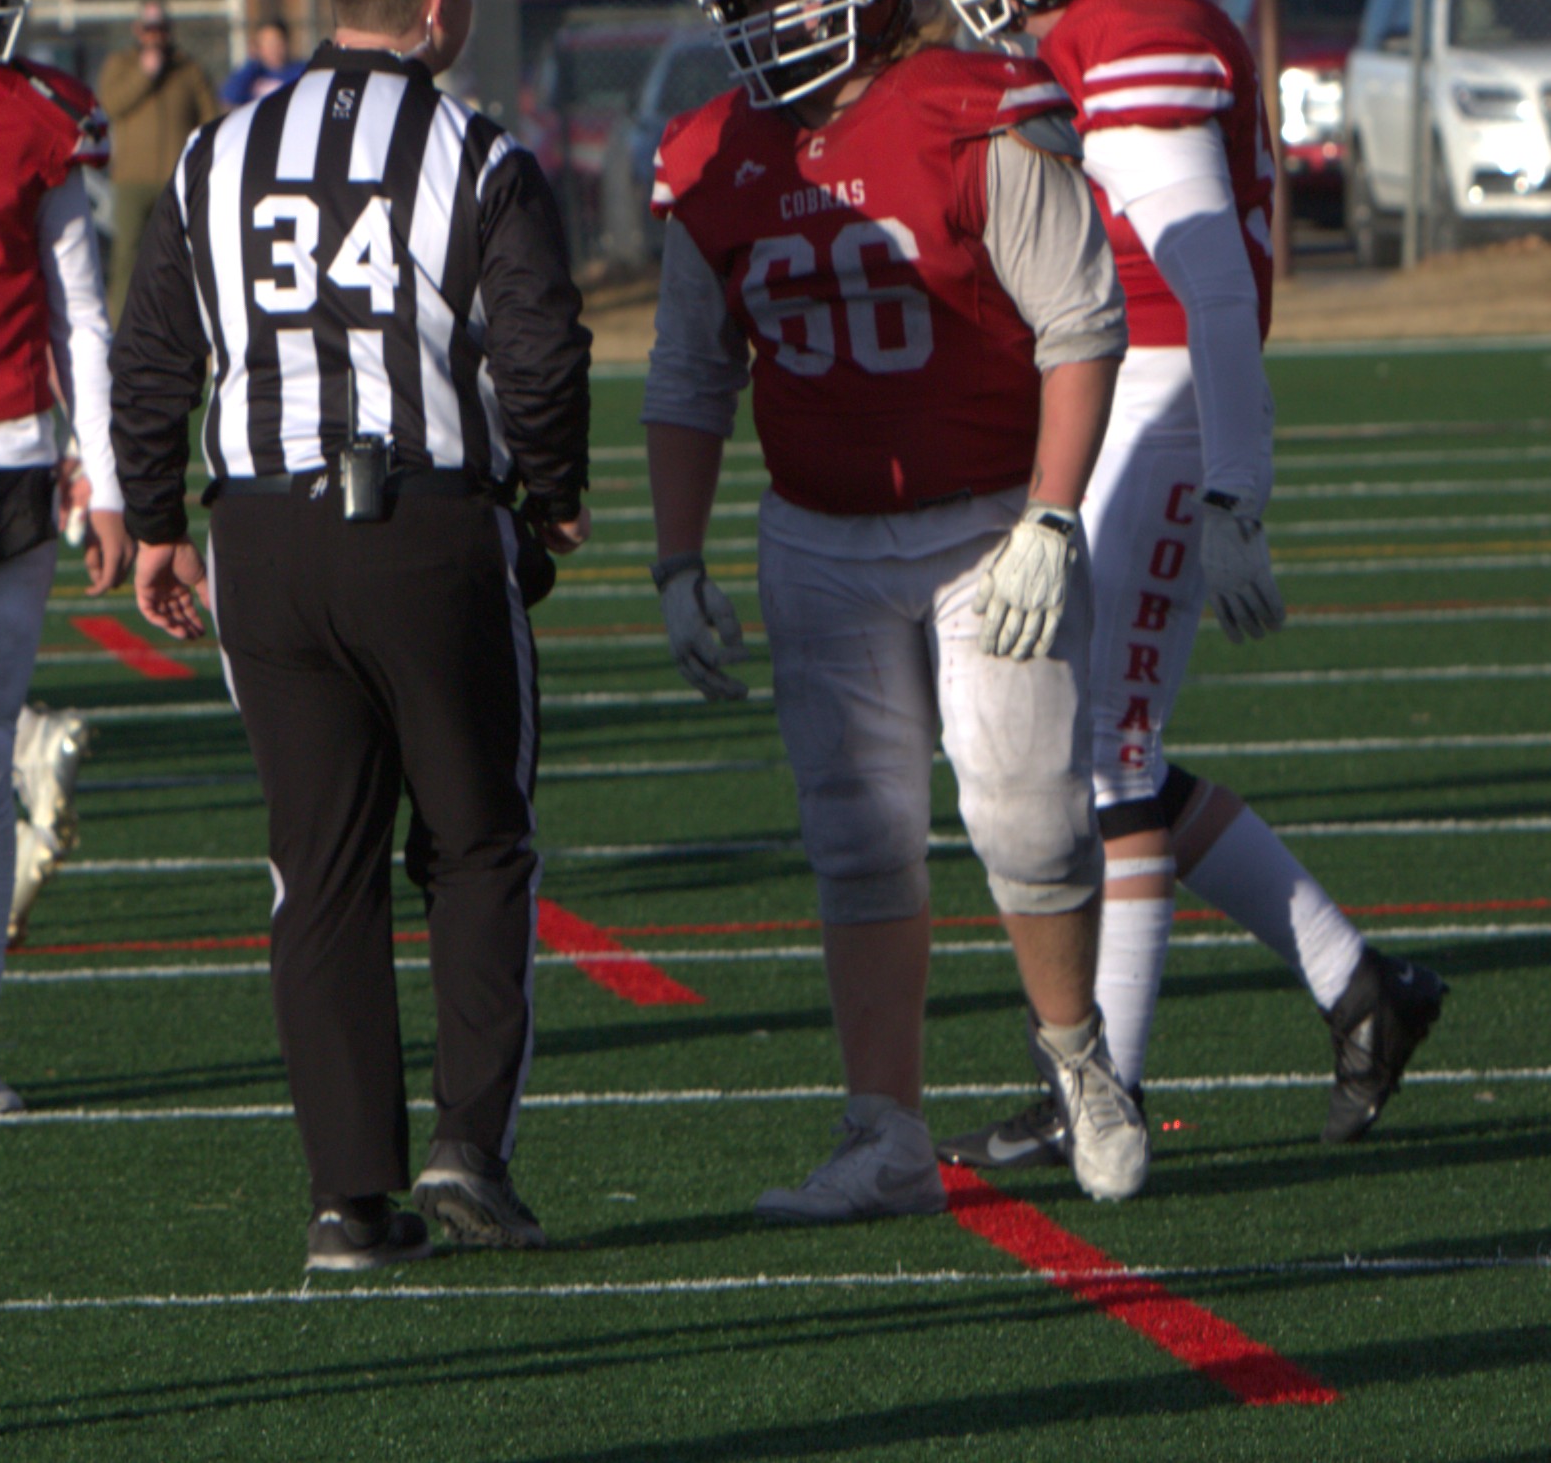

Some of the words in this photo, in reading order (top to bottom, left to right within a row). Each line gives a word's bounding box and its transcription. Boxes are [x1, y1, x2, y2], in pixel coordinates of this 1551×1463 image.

[253, 194, 400, 313] 34
[780, 179, 866, 220] COBRAS
[742, 216, 934, 376] 66
